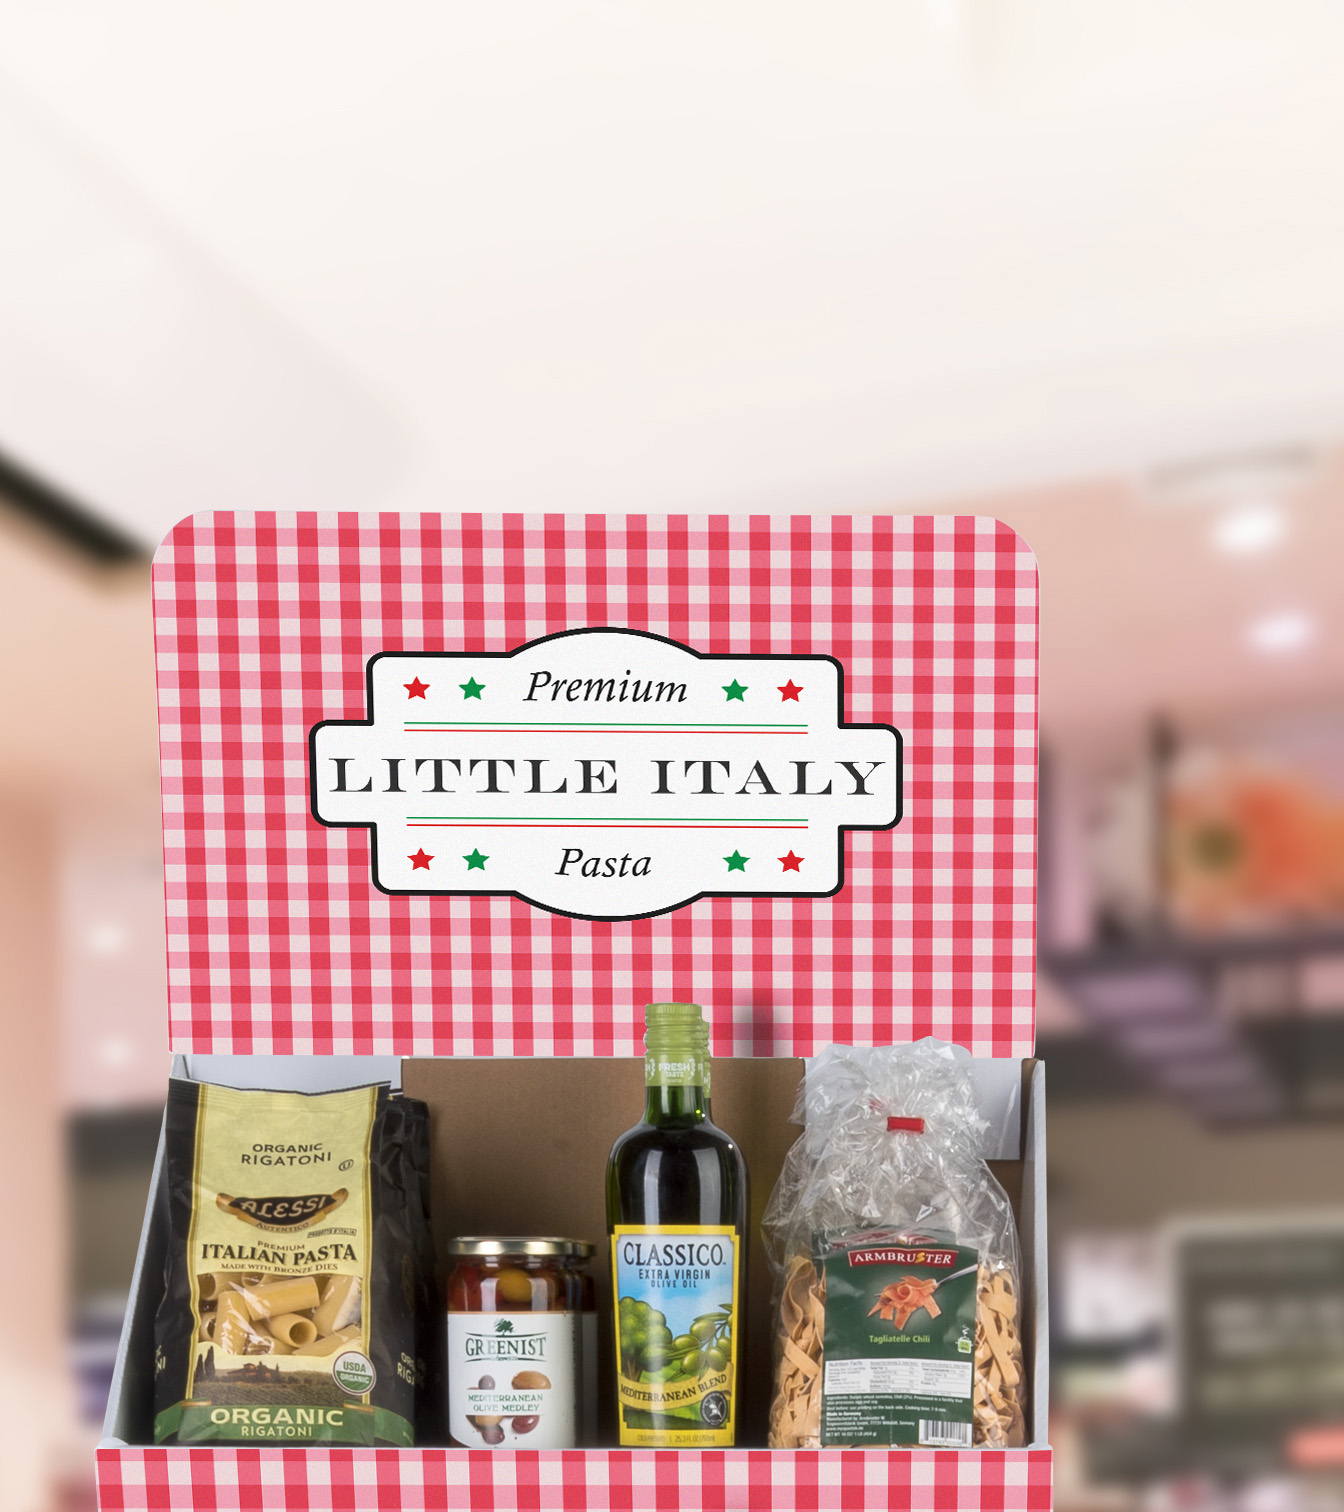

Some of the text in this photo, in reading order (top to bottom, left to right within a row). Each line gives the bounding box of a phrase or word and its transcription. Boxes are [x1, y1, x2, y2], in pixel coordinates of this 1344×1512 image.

[522, 670, 688, 704] Premium
[328, 757, 886, 797] LITTLE ITALY
[555, 847, 652, 880] Pasta
[252, 1143, 323, 1153] ORGANIC
[241, 1152, 332, 1167] RIGATONI
[240, 1196, 326, 1219] ALESSI
[256, 1222, 309, 1233] AUTENTICO
[257, 1240, 305, 1251] PREMIUM
[201, 1243, 357, 1265] ITALIAN PASTA
[623, 1242, 724, 1266] CLASSICO
[854, 1252, 952, 1265] ARMBRUSTER
[274, 1265, 313, 1274] BRONZE
[315, 1263, 338, 1271] DIES
[639, 1269, 711, 1280] EXTRA VIRGIN
[651, 1280, 698, 1288] OLIVE OIL
[869, 1334, 931, 1344] Tagliatelle Chili
[465, 1336, 547, 1356] GREENIST
[343, 1361, 366, 1373] USDA
[340, 1373, 371, 1384] ORGANIC
[620, 1374, 728, 1402] MEDITERRANEAN BLEND
[468, 1394, 543, 1402] MEDITERRANEAN
[473, 1403, 540, 1412] OLIVE MEDLEY
[211, 1407, 344, 1426] ORGANIC
[241, 1425, 313, 1438] RIGATONI
